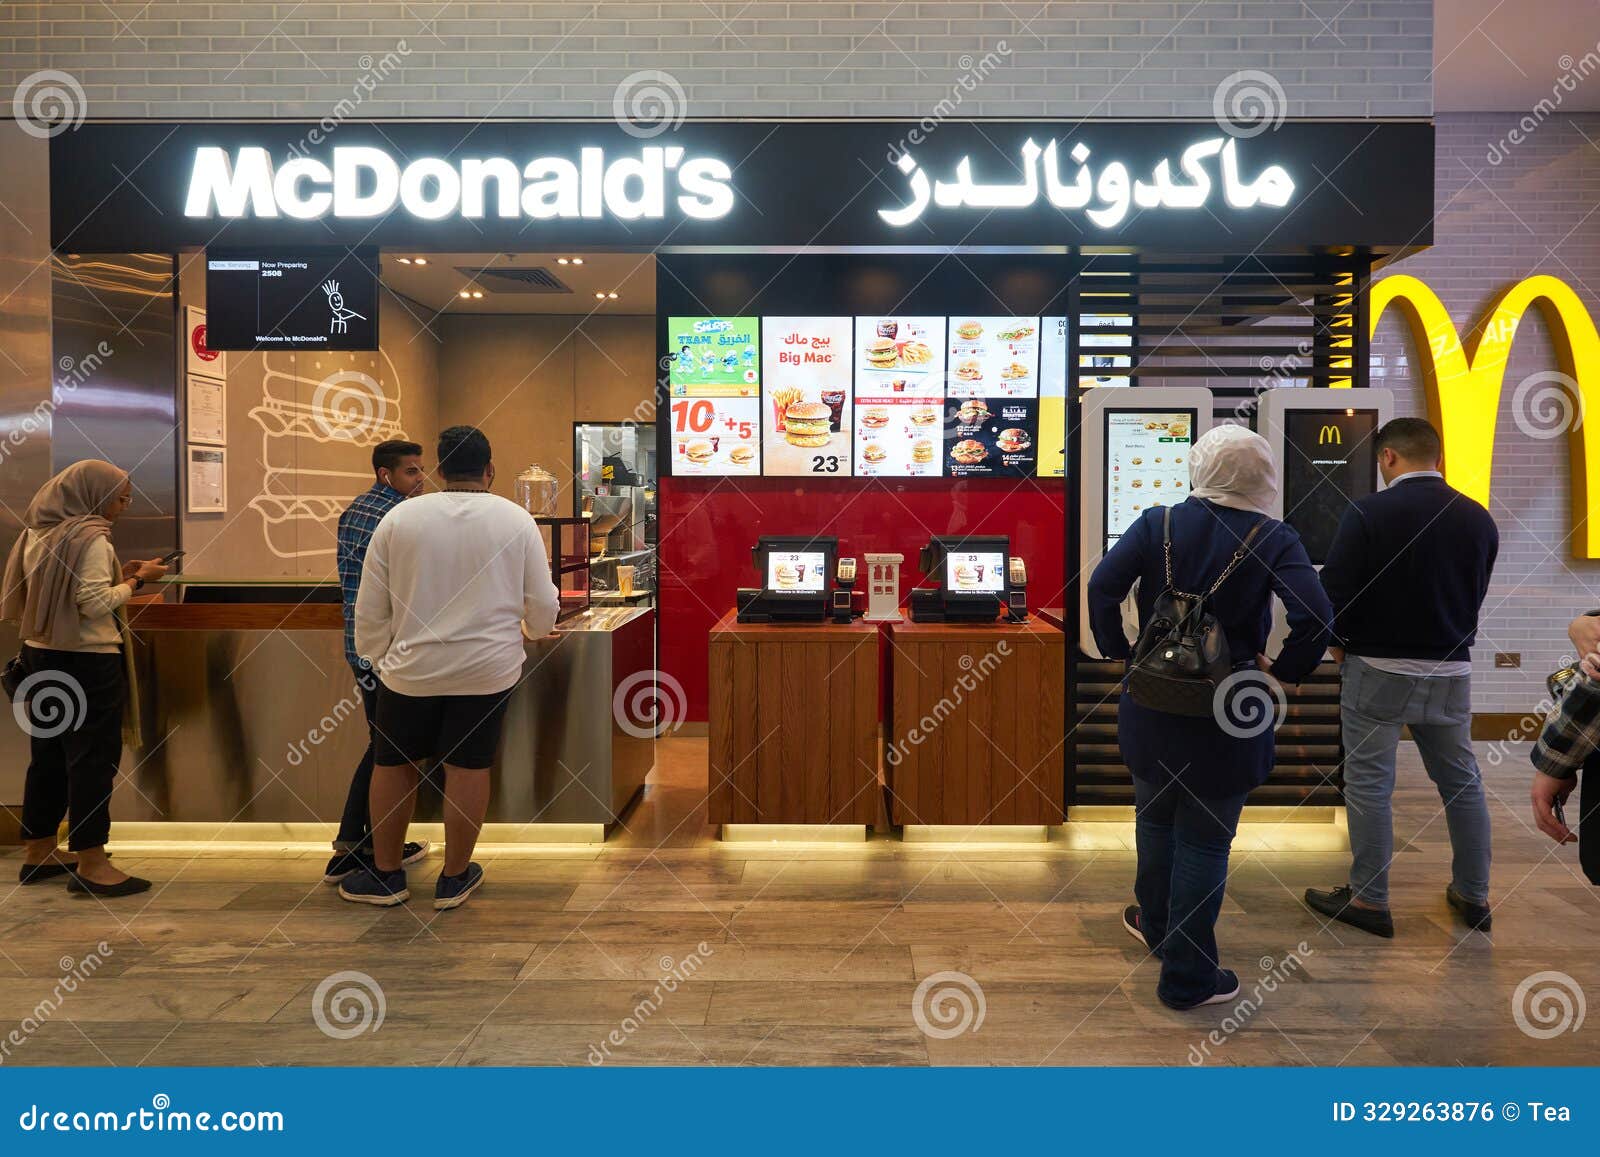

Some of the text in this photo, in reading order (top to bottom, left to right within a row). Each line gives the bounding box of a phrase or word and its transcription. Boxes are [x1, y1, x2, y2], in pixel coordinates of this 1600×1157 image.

[184, 146, 735, 219] McDonald's
[878, 137, 1297, 228] ماكدونالدز
[277, 262, 308, 270] Preparing
[677, 336, 712, 345] TEAM
[779, 352, 832, 365] Big Mac
[672, 400, 714, 433] 10
[812, 455, 839, 473] 23
[790, 554, 800, 562] 23
